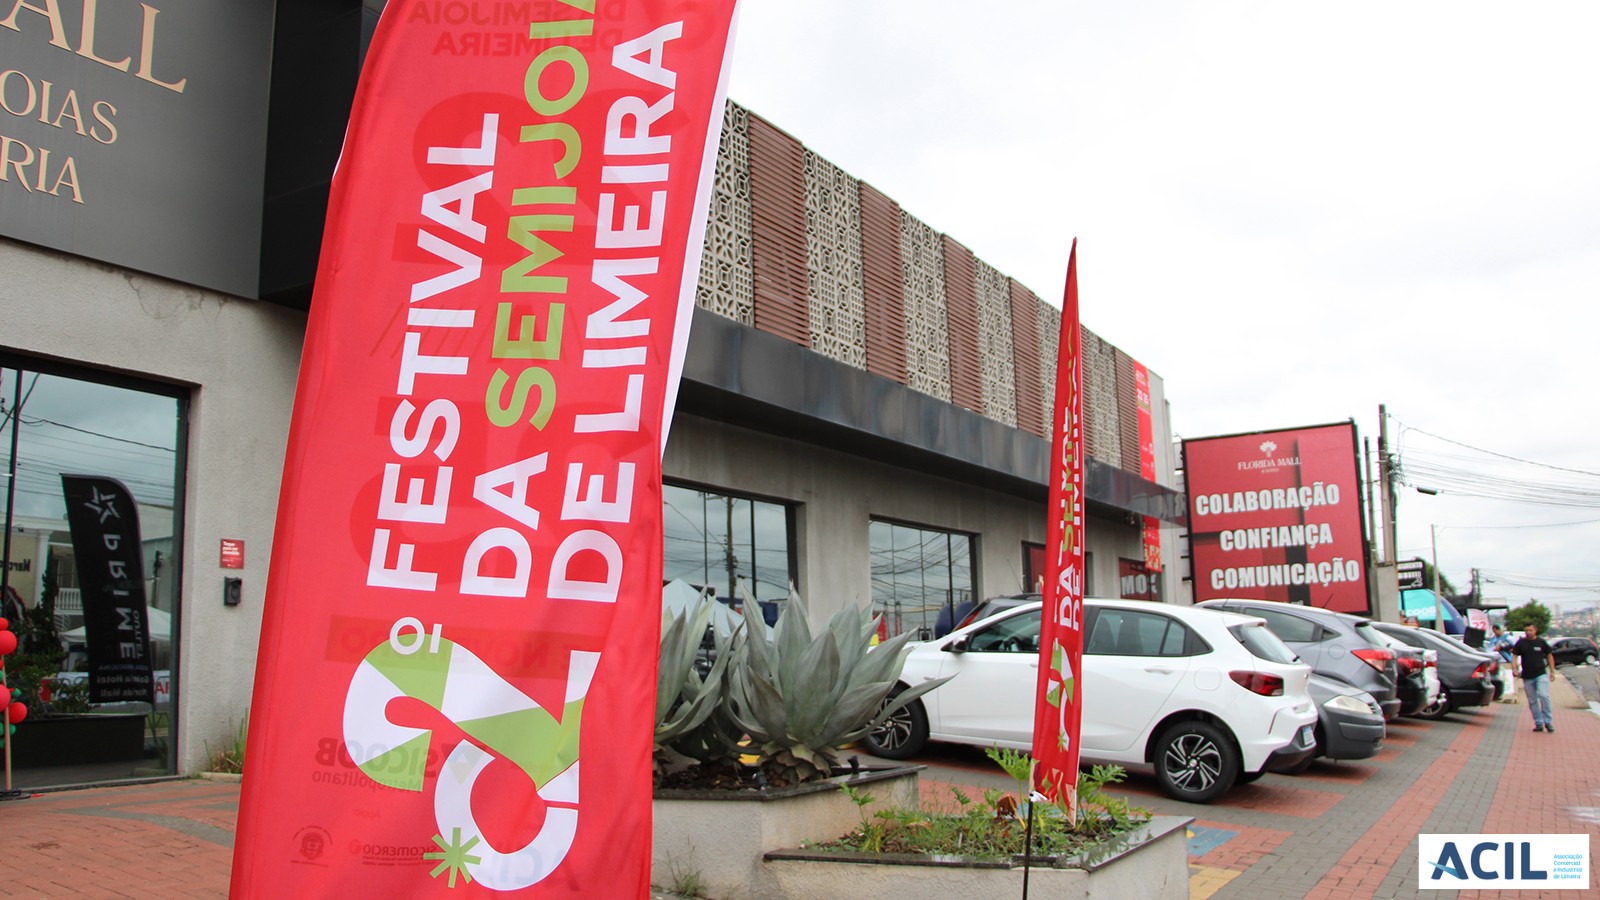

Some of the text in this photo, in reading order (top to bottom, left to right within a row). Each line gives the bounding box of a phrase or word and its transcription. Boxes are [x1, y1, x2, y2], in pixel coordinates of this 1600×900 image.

[574, 20, 684, 433] LIMEIRA
[459, 0, 596, 597] DA SEMIJOI
[366, 113, 499, 591] FESTIVAL
[1196, 482, 1340, 516] COLABORAÇÃO
[1238, 459, 1276, 470] FLORIDA
[1277, 456, 1302, 466] MALL
[547, 462, 636, 603] DE
[1211, 557, 1360, 590] COMUNICAÇÃO
[1219, 523, 1333, 551] CONFIANÇA
